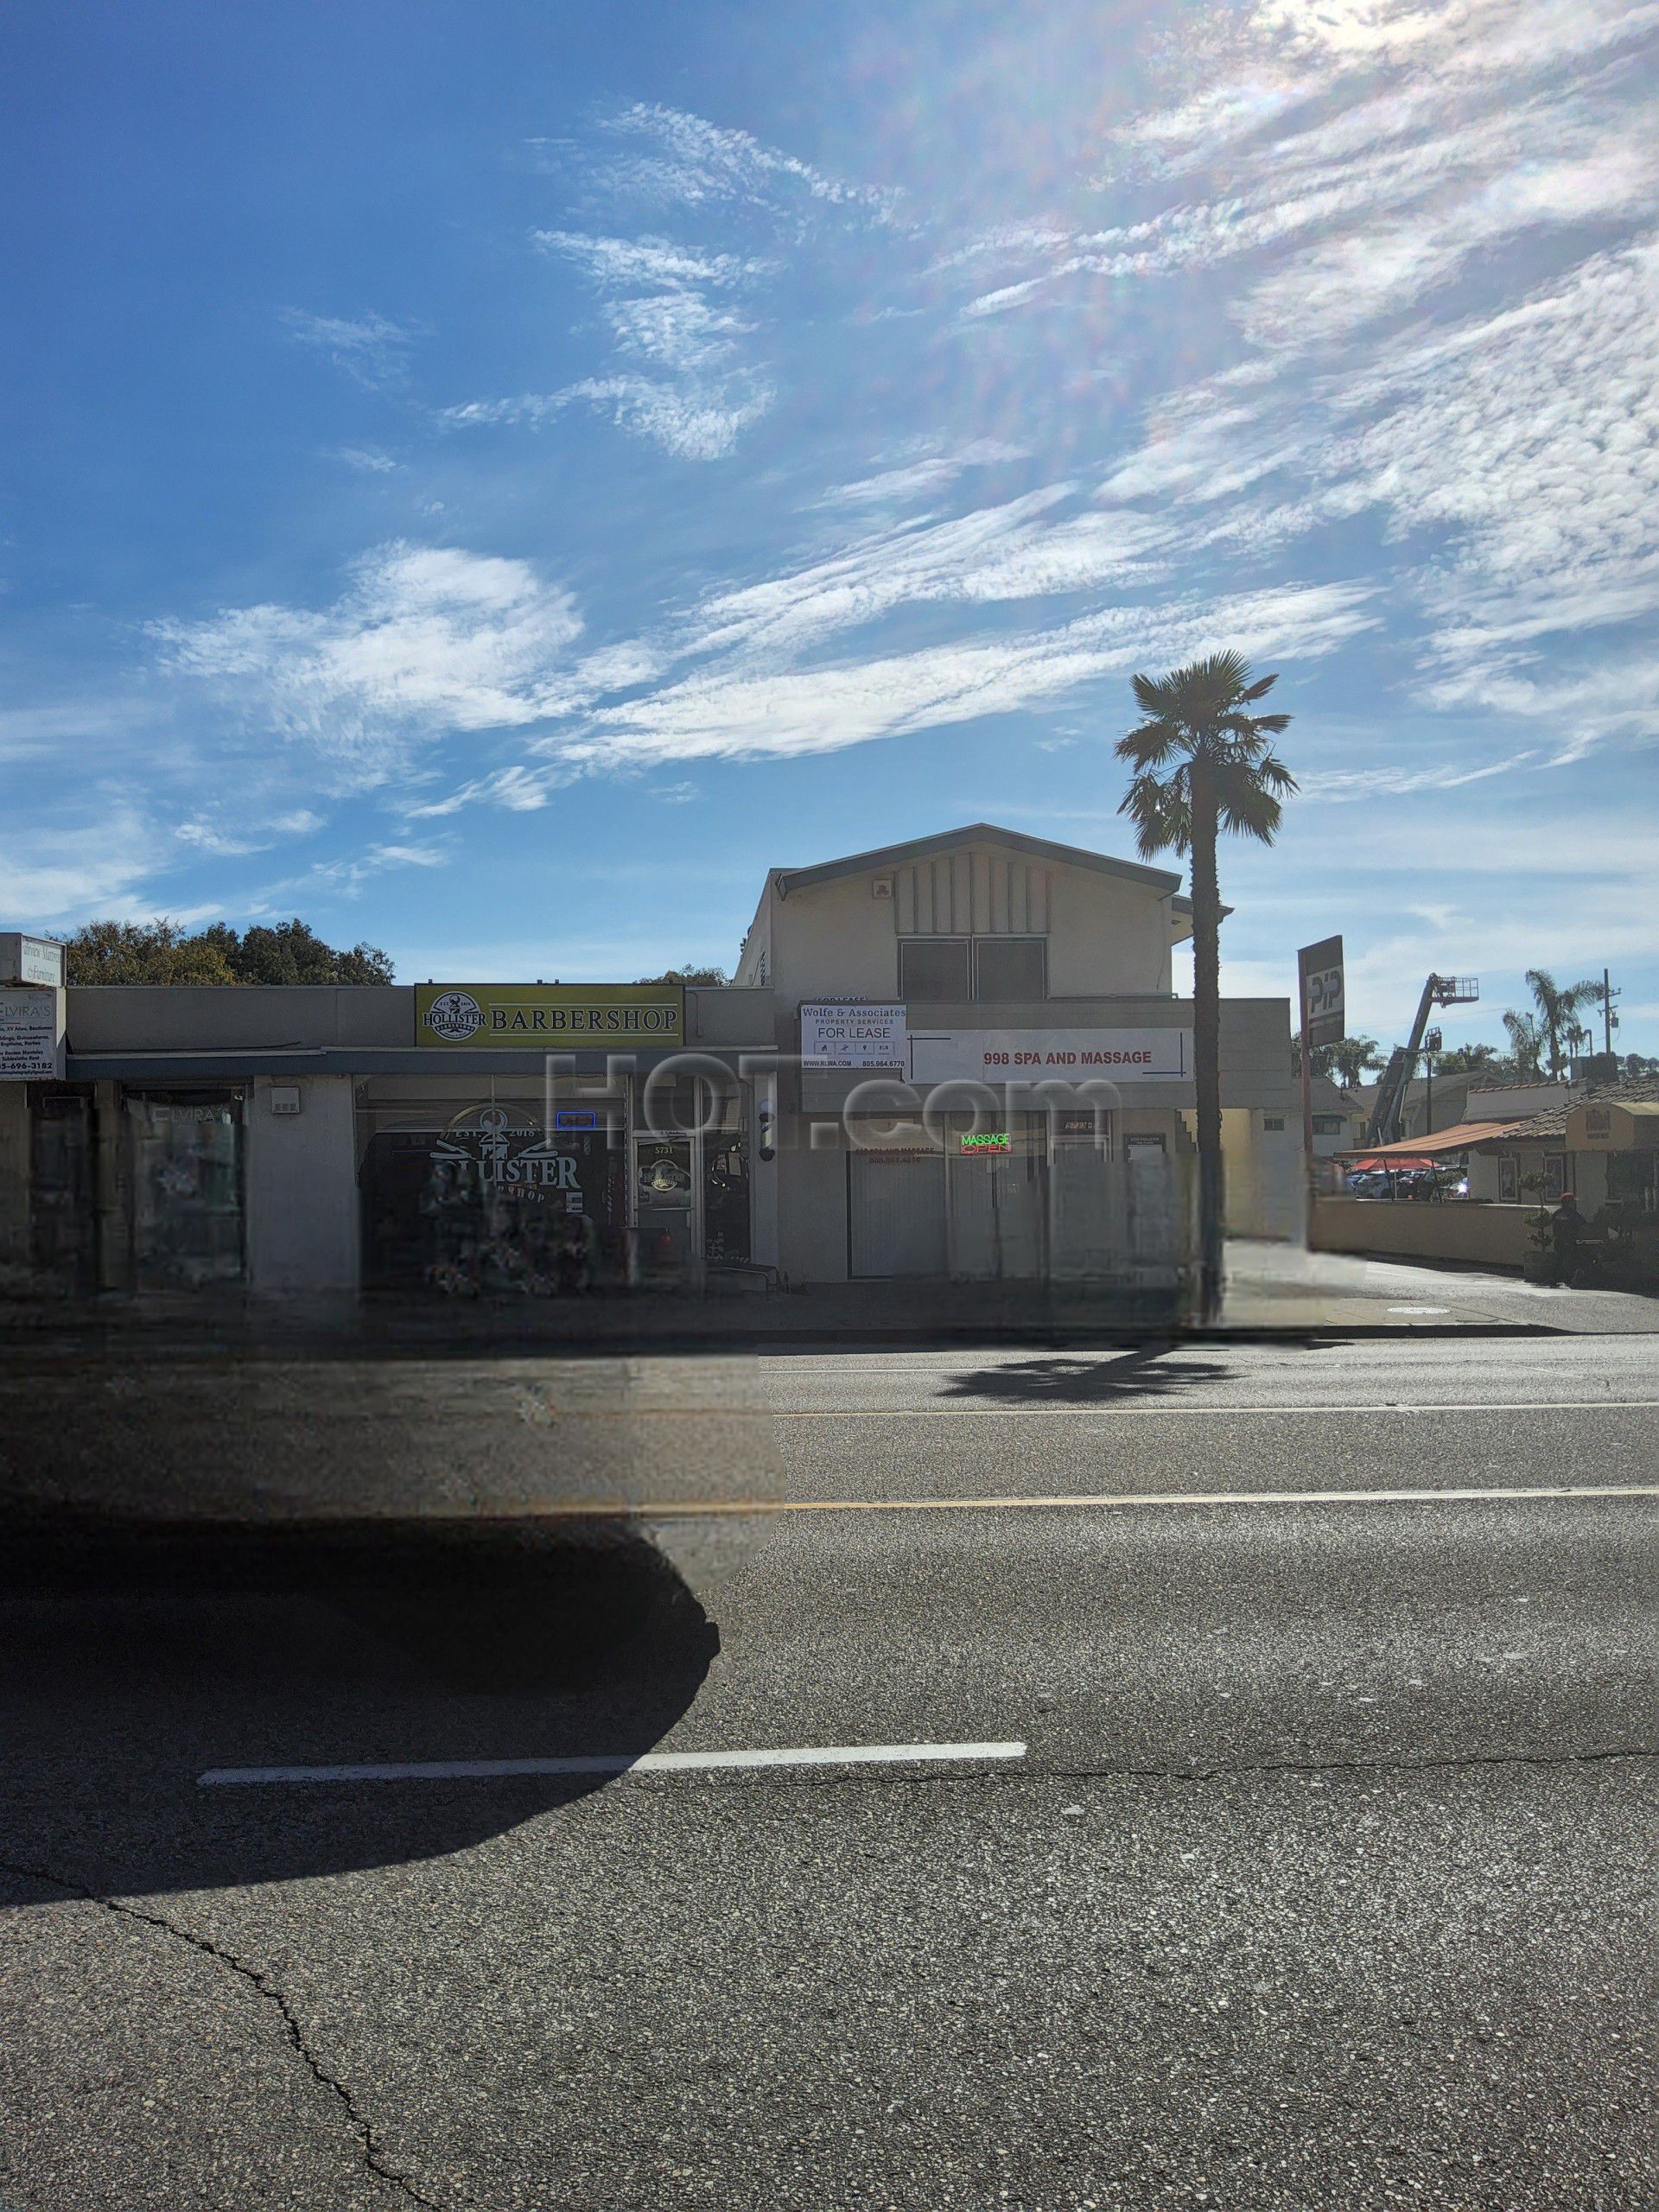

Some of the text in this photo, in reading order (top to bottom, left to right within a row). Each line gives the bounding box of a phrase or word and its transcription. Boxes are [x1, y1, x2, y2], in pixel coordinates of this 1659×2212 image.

[803, 1007, 906, 1018] Wolfe & Associates
[423, 1012, 487, 1027] HOLLISTER
[489, 1008, 678, 1031] BARBERSHOP
[818, 1027, 891, 1039] FOR LEASE
[983, 1051, 1152, 1065] 998 SPA AND MASSAGE
[962, 1135, 1009, 1145] MASSAGE
[962, 1145, 1011, 1154] OPEN
